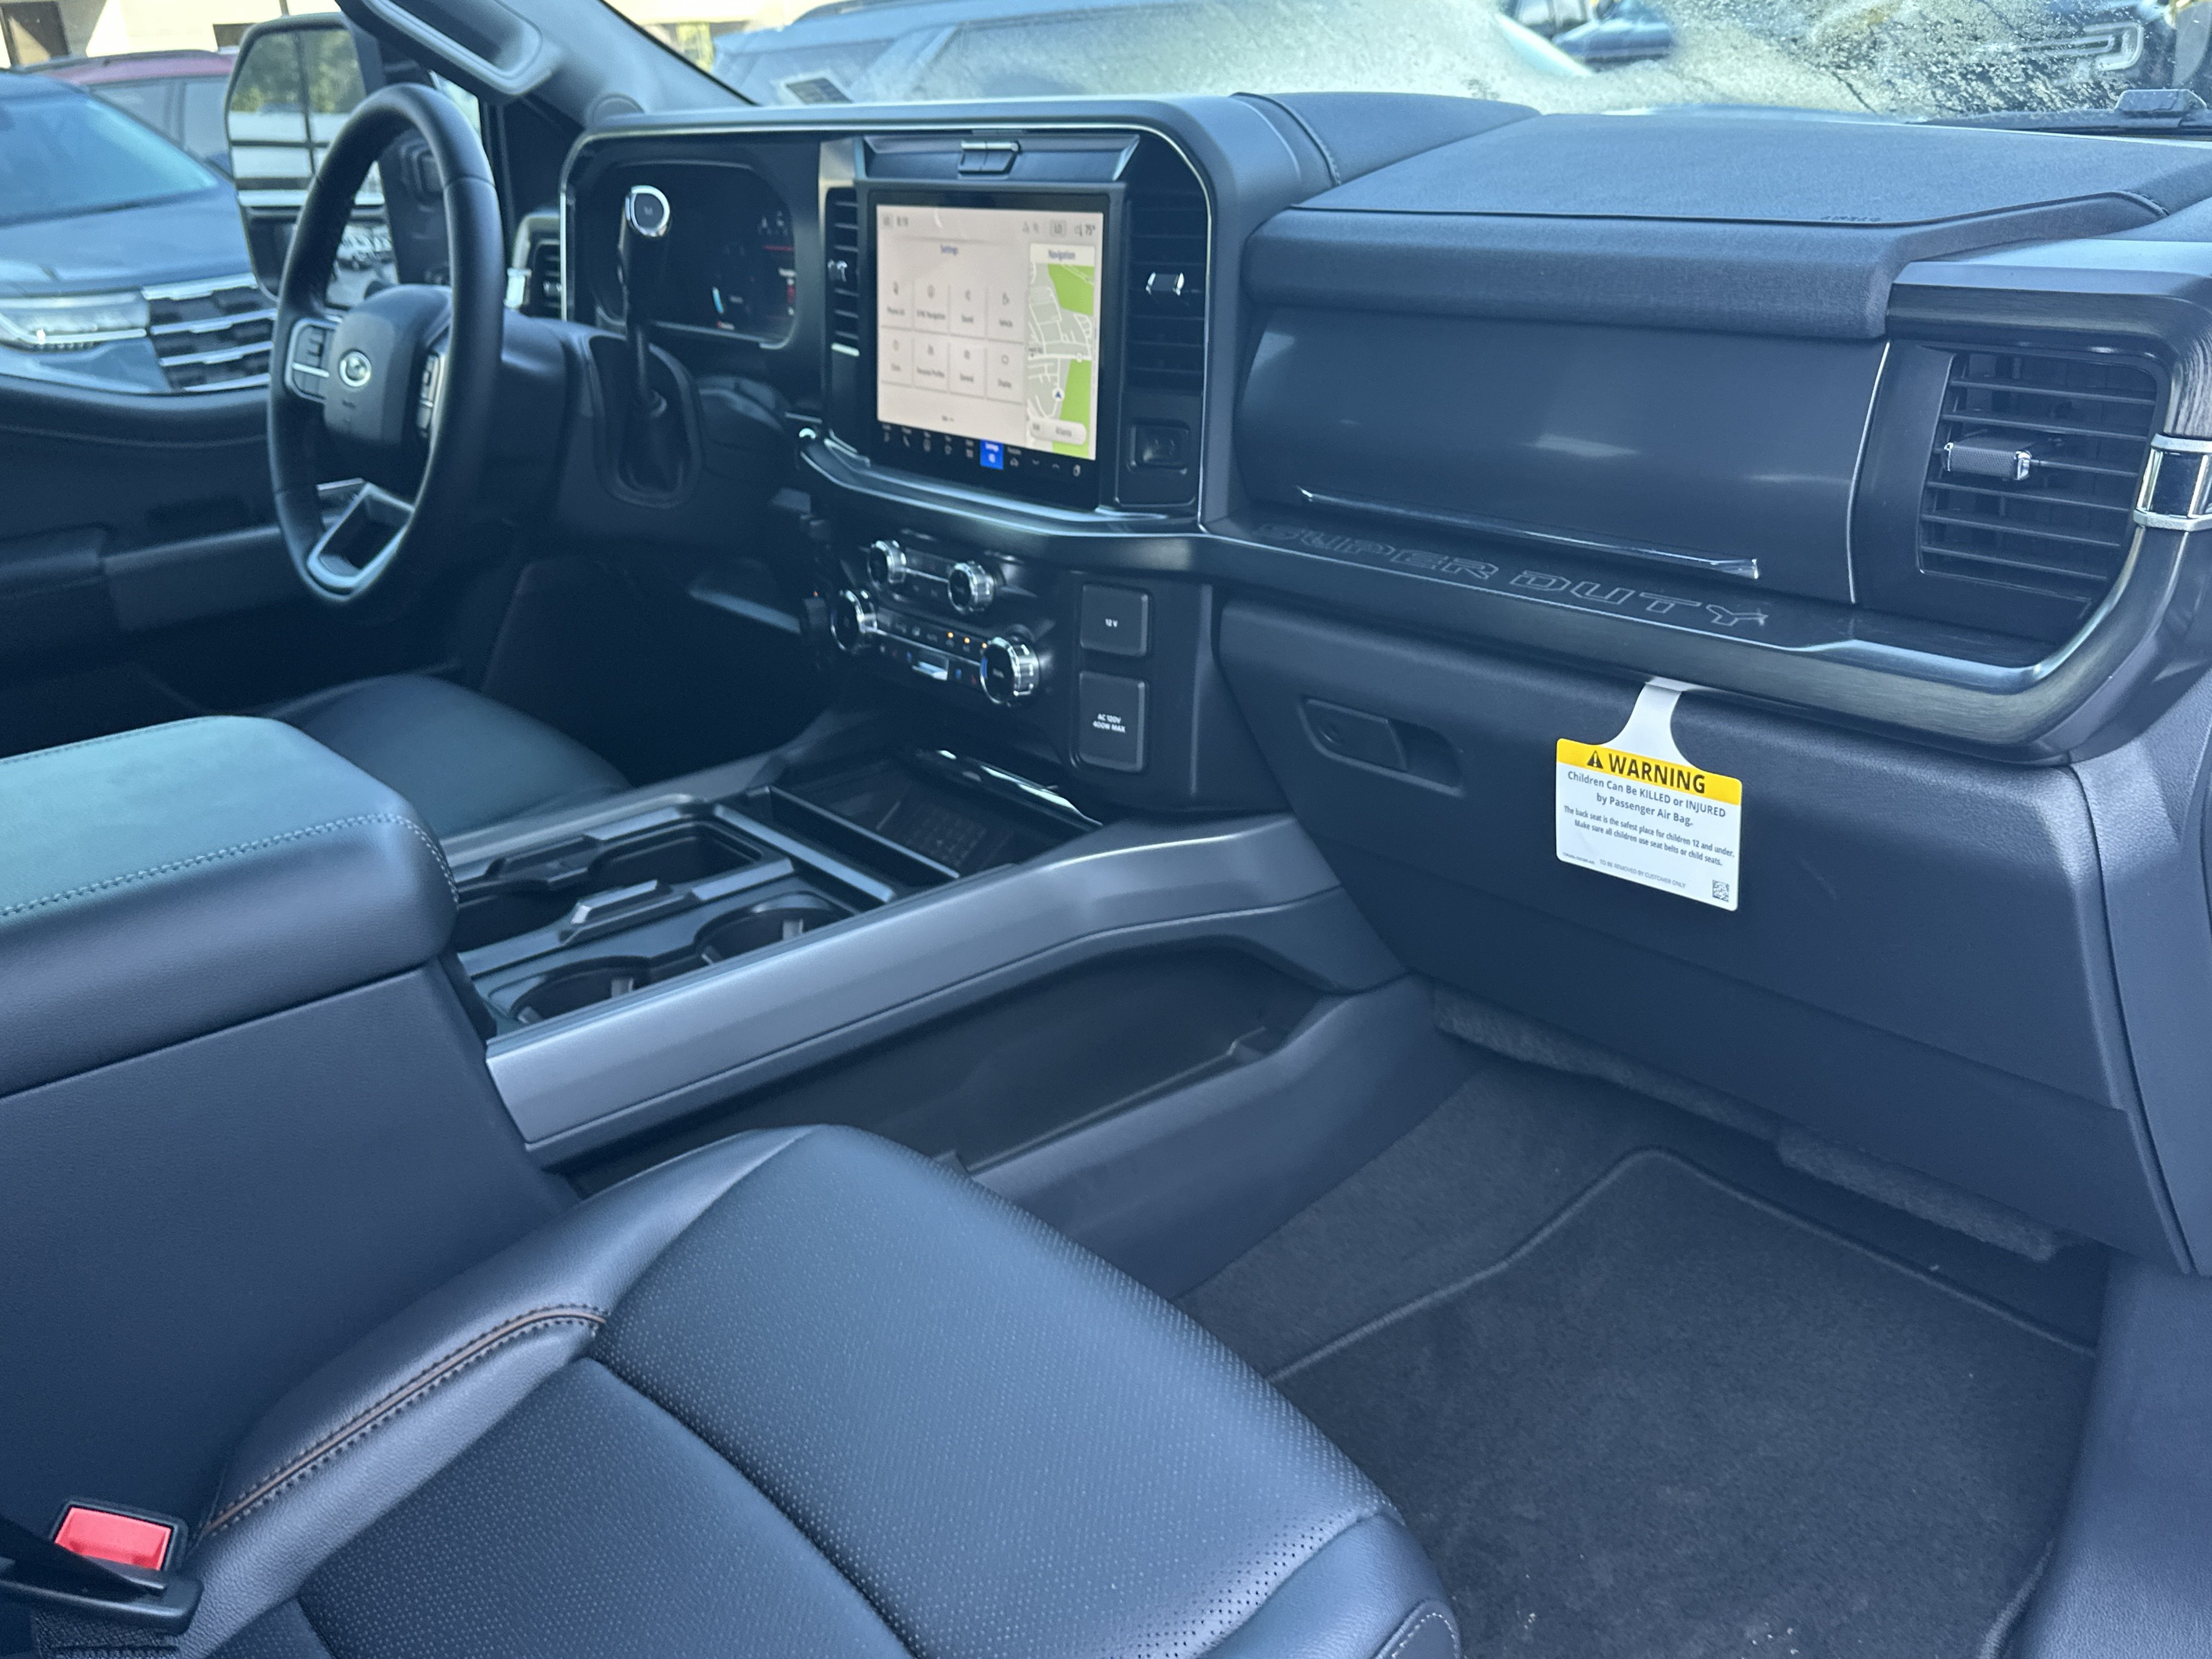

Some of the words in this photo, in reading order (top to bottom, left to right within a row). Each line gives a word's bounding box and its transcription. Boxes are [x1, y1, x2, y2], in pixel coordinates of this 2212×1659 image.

[1510, 569, 1768, 627] DUTY
[1097, 713, 1106, 721] AC
[1106, 714, 1121, 724] 120V
[1111, 724, 1126, 733] MAX
[1567, 771, 1604, 788] Children
[1606, 780, 1623, 792] Can
[1626, 785, 1637, 795] Be
[1639, 788, 1671, 804] KILLED
[1673, 798, 1684, 807] or
[1686, 799, 1726, 817] INJURED
[1609, 753, 1706, 794] WARNING
[1596, 793, 1607, 805] by
[1610, 796, 1655, 816] Passenger
[1657, 808, 1671, 820] Air
[1673, 812, 1693, 827] Bag.
[1564, 805, 1575, 815] The
[1575, 808, 1589, 818] back
[1590, 813, 1602, 822] seat
[1603, 815, 1608, 823] is
[1610, 817, 1619, 826] the
[1620, 821, 1638, 831] safest
[1639, 825, 1655, 836] place
[1656, 829, 1665, 839] for
[1666, 832, 1691, 845] children
[1692, 839, 1700, 848] 12
[1701, 843, 1713, 851] and
[1714, 847, 1735, 858] under.
[1575, 819, 1590, 830] Make
[1592, 825, 1604, 833] sure
[1613, 830, 1638, 842] children
[1650, 840, 1663, 849] seat
[1664, 843, 1679, 854] belts
[1688, 850, 1703, 861] child
[1704, 855, 1723, 866] seats.
[1614, 863, 1638, 874] REMOVED
[1644, 872, 1672, 884] CUSTOMER
[1672, 879, 1686, 888] ONLY
